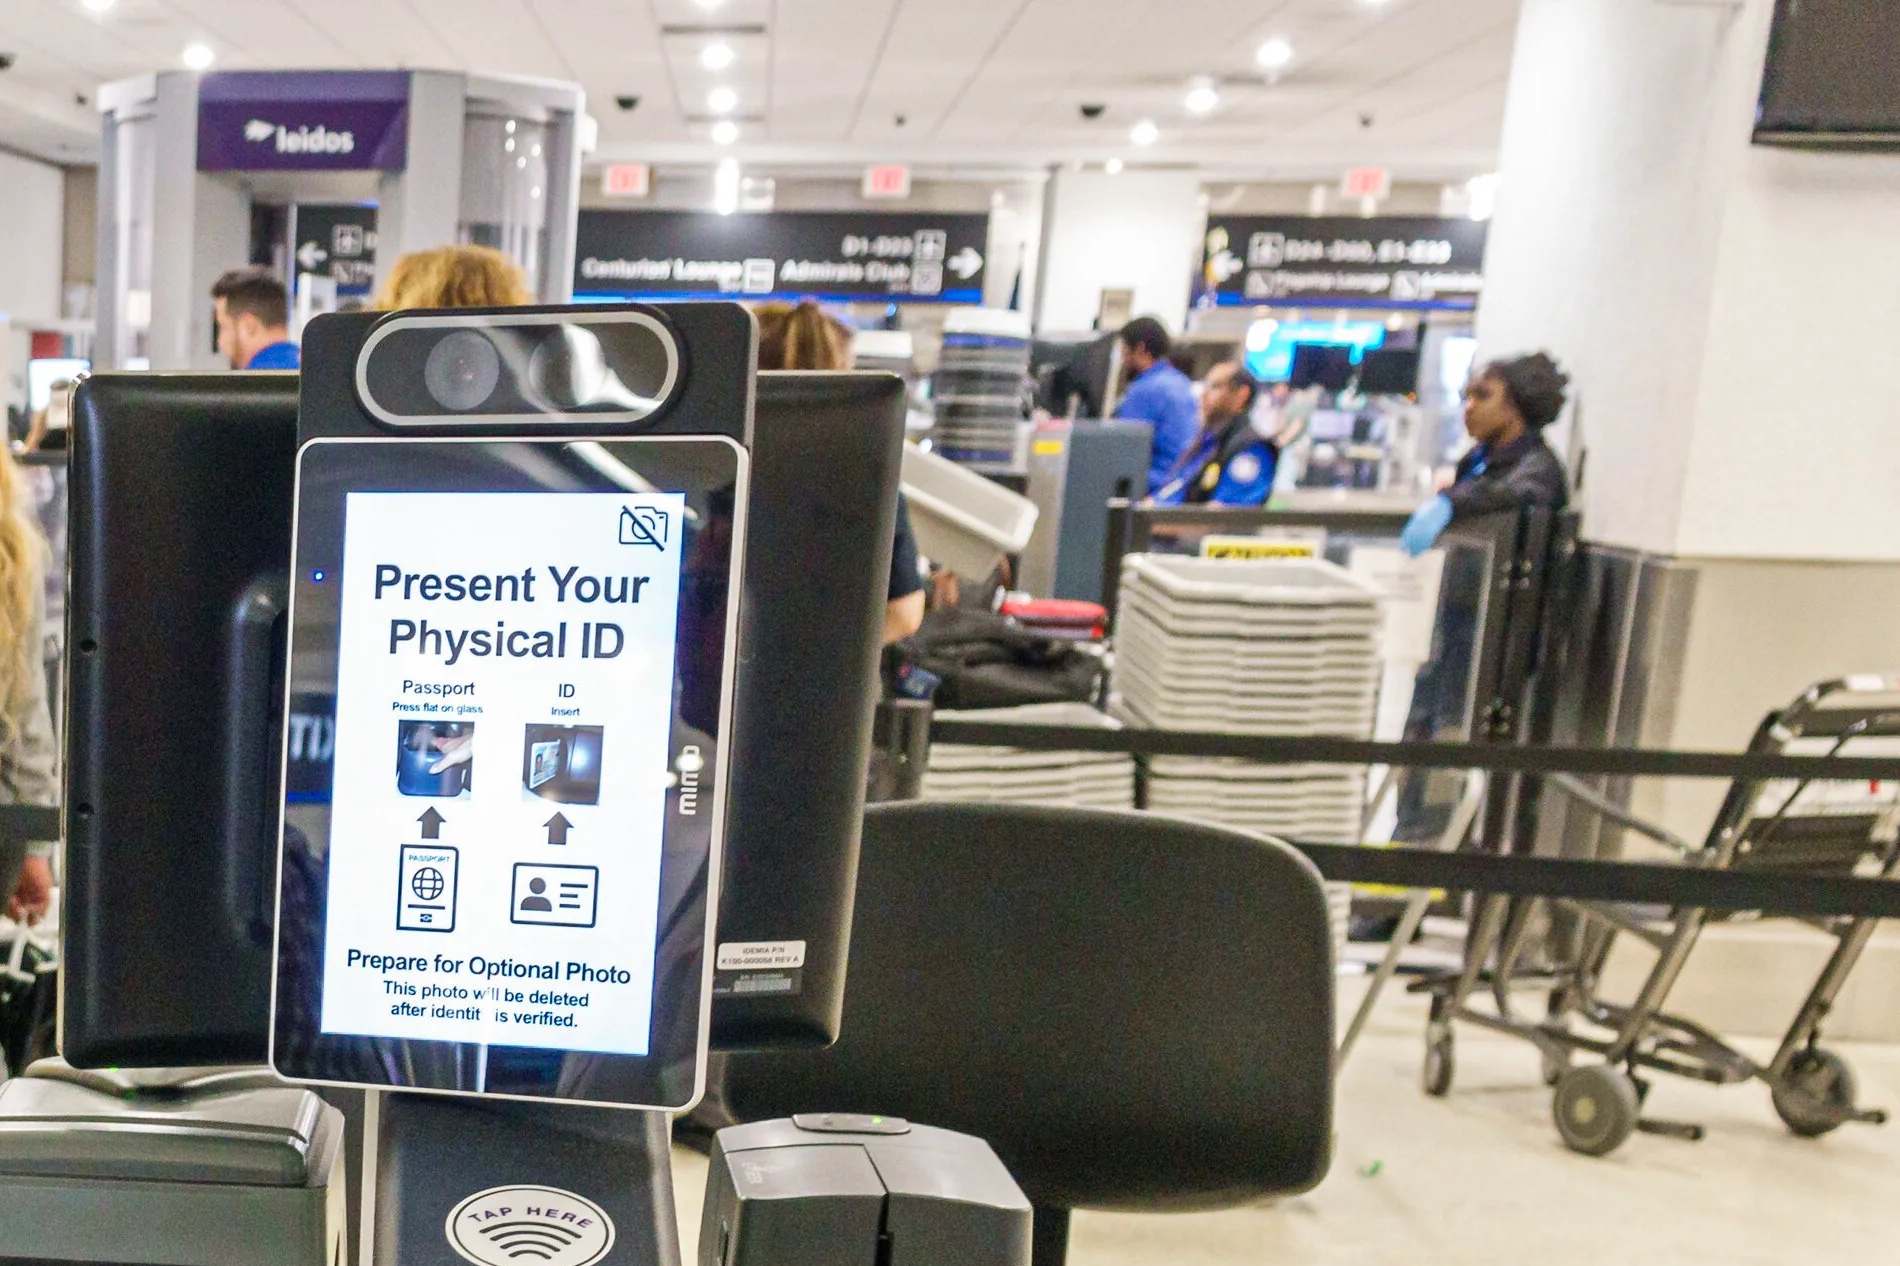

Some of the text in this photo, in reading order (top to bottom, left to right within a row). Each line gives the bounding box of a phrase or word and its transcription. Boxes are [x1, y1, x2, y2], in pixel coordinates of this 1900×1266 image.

[276, 124, 355, 153] leidos
[375, 564, 650, 604] Present Your
[389, 619, 624, 666] Physical ID
[402, 680, 475, 697] Passport
[558, 684, 575, 698] ID
[393, 702, 420, 712] Press
[424, 703, 438, 712] flat
[457, 705, 483, 715] glass
[552, 708, 580, 716] Insert
[347, 948, 631, 984] Prepare for Optional Photo
[383, 980, 417, 996] This
[422, 984, 468, 1000] photo
[504, 988, 524, 1003] be
[529, 990, 589, 1007] deleted
[391, 1002, 578, 1027] after identit is verified.
[468, 1207, 593, 1228] TAP HERE
